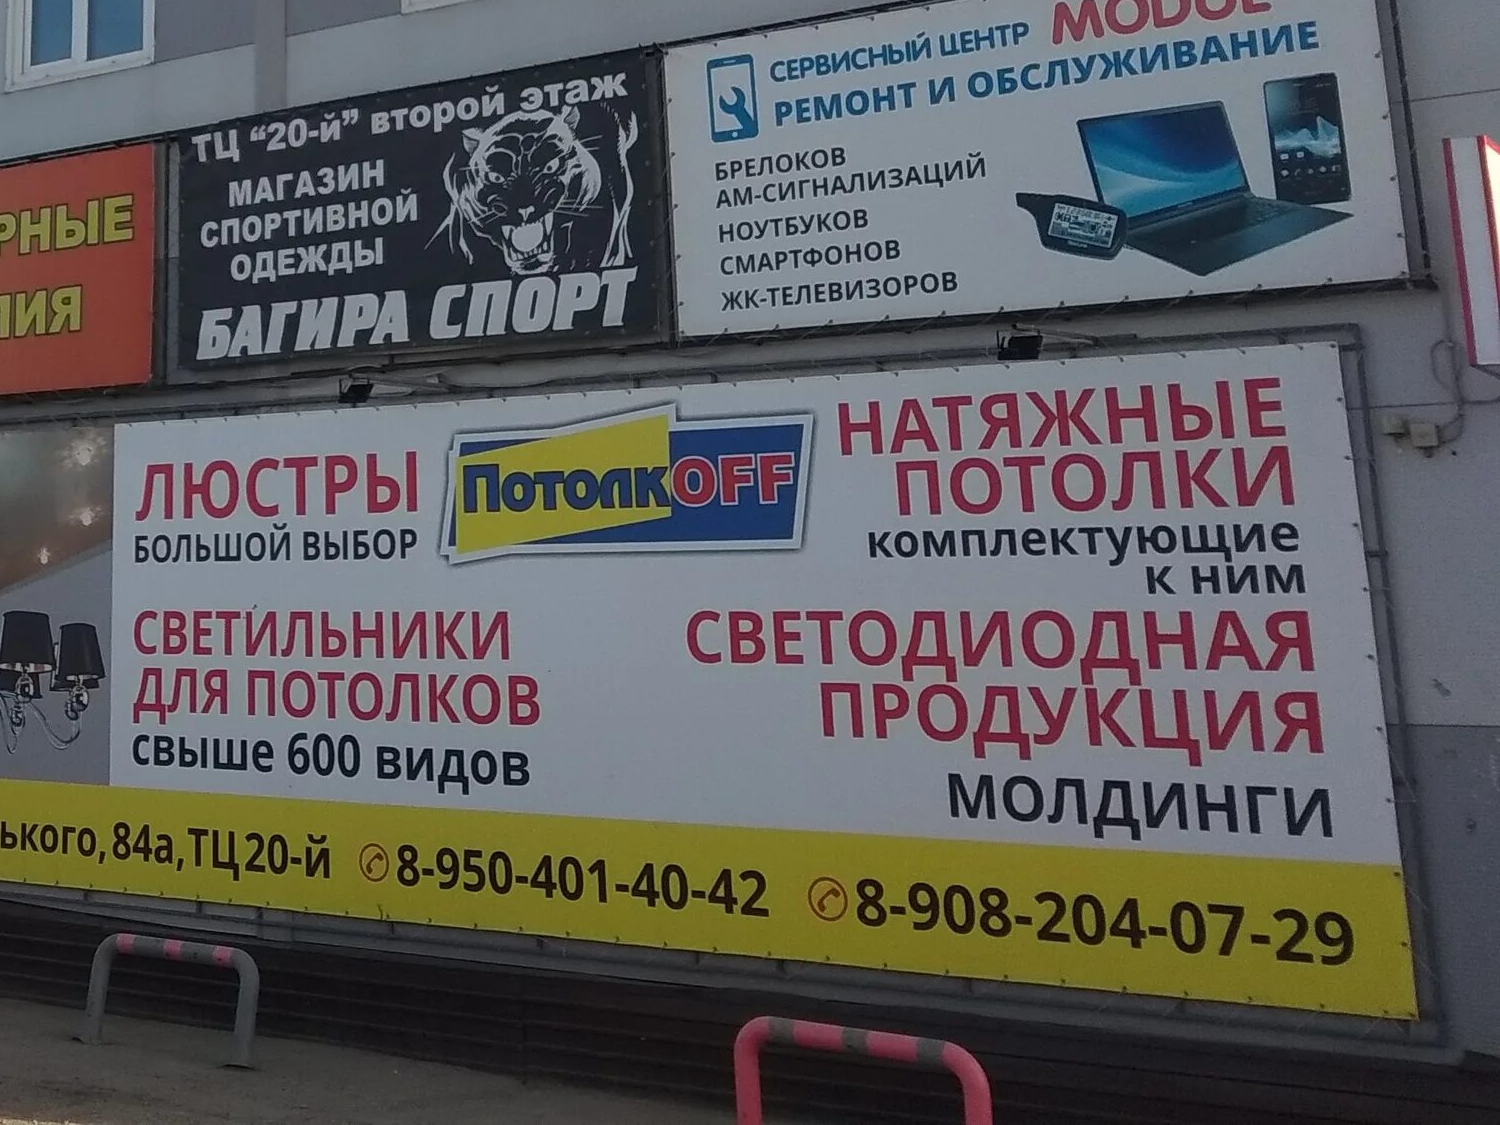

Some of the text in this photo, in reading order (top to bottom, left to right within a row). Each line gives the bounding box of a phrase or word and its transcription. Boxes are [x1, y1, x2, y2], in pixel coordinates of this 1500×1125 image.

[768, 31, 933, 83] СЕРВИСНЫЙ
[940, 21, 1030, 59] ЦЕНТР
[773, 20, 1320, 127] РЕМОНТ И ОБСЛУЖИВАНИЕ
[192, 129, 241, 166] ТЦ
[370, 82, 505, 136] второй
[519, 72, 630, 114] этаж
[228, 159, 386, 209] МАГАЗИН
[714, 145, 847, 183] БРЕЛОКОВ
[715, 153, 987, 210] АМ-СИГНАЛИЗАЦИЙ
[199, 188, 419, 250] СПОРТИВНОЙ
[717, 208, 869, 244] НОУТБУКОВ
[230, 237, 385, 283] ОДЕЖДЫ
[720, 238, 901, 277] СМАРТФОНОВ
[196, 267, 638, 363] БАГИРА СПОРТ
[720, 270, 959, 312] ЖК-ТЕЛЕВИЗОРОВ
[838, 377, 1286, 457] НАТЯЖНЫЕ
[135, 451, 420, 522] ЛЮСТРЫ
[896, 446, 1295, 515] ПОТОЛКИ
[133, 523, 418, 564] БОЛЬШОЙ ВЫБОР
[868, 521, 1300, 564] комплектующие
[1146, 563, 1306, 595] к ним
[132, 609, 511, 661] СВЕТИЛЬНИКИ
[687, 609, 1315, 686] СВЕТОДИОДНАЯ
[132, 668, 542, 727] ДЛЯ ПОТОЛКОВ
[820, 682, 1326, 765] ПРОДУКЦИЯ
[131, 732, 531, 794] свыше 600 видов
[948, 773, 1333, 839] МОЛДИНГИ
[396, 844, 770, 917] 8-950-401-40-42
[855, 878, 1354, 965] 8-908-204-07-29
